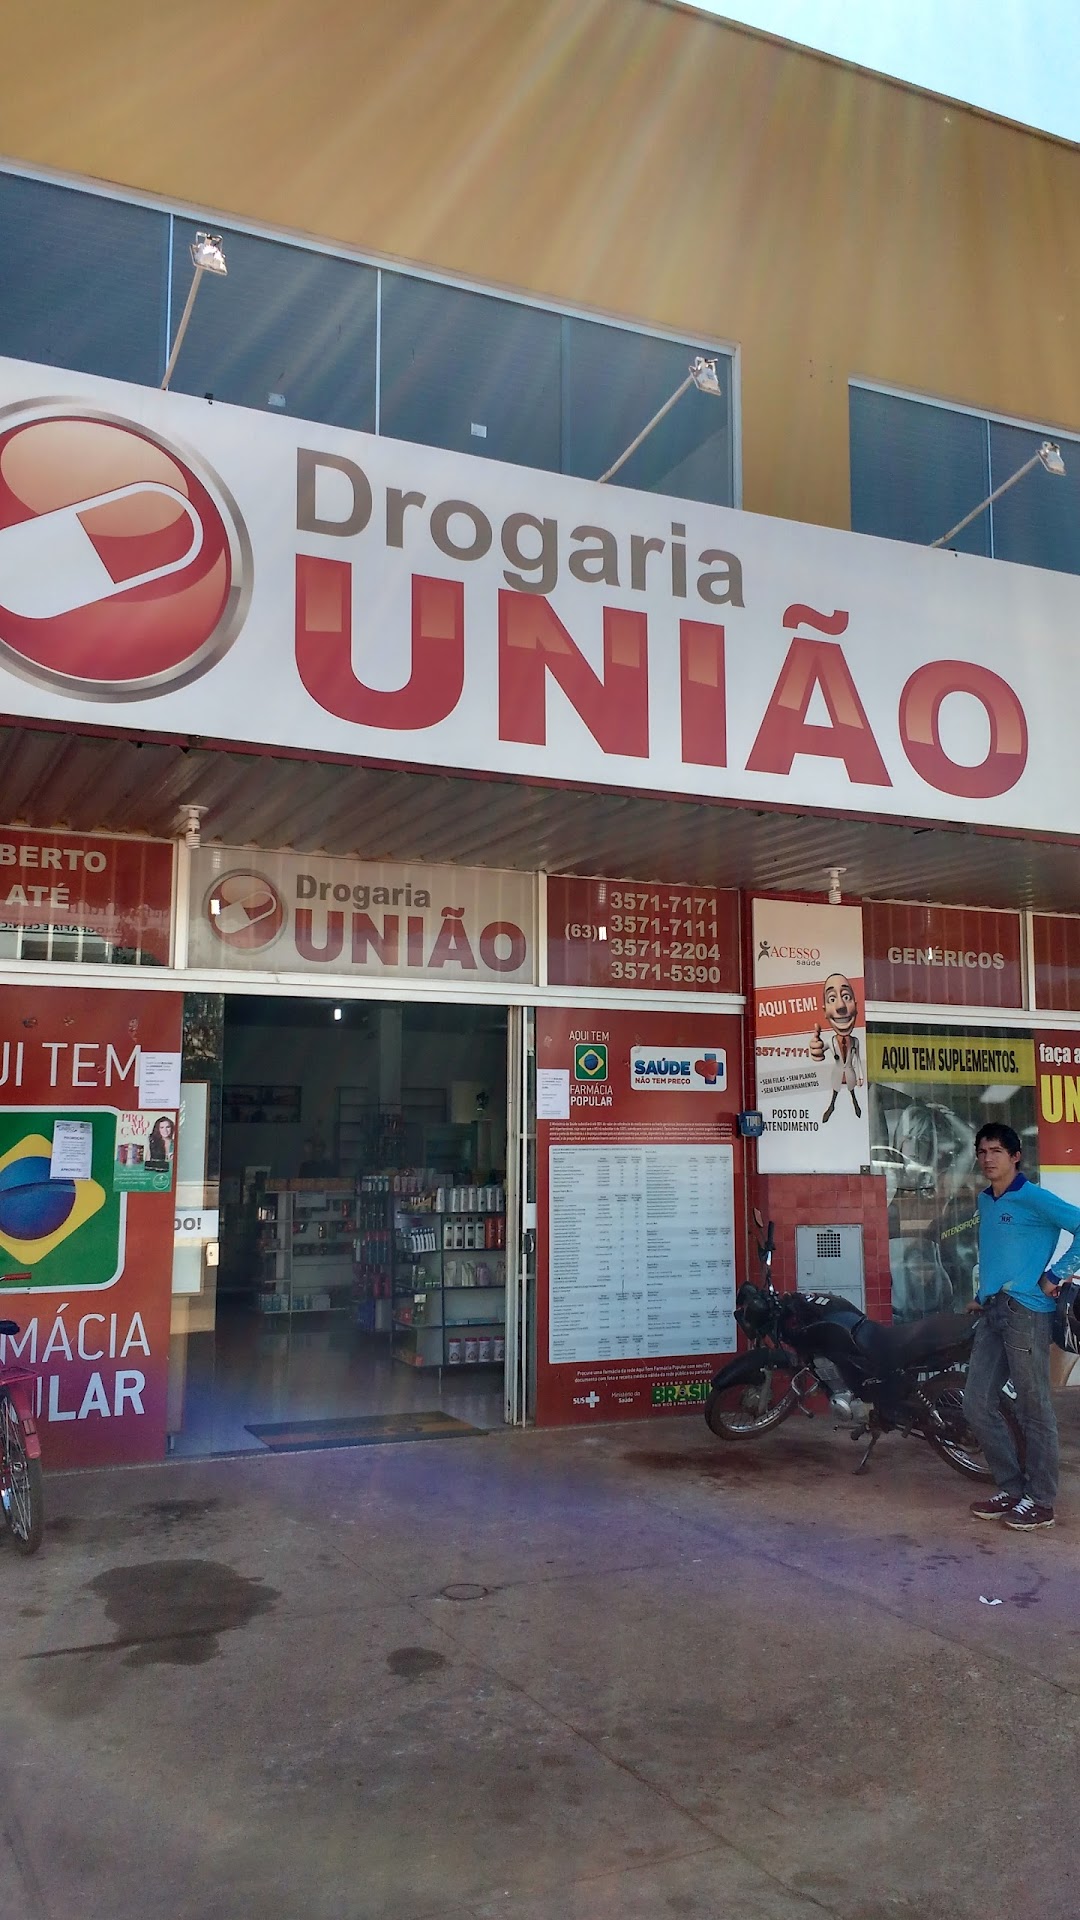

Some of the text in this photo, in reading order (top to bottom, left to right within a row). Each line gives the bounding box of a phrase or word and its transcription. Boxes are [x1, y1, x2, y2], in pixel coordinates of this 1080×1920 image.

[296, 447, 745, 608] Drogaria
[294, 553, 1029, 798] UNIÃO
[5, 883, 71, 909] ATÉ
[295, 874, 431, 909] Drogaria
[611, 891, 718, 916] 3571-7171
[564, 923, 598, 942] (63)
[611, 915, 718, 938] 3571-7111
[294, 906, 526, 972] UNIÃO
[611, 939, 720, 961] 3571-2204
[770, 946, 820, 960] ACESSO
[796, 959, 821, 967] saúde
[887, 945, 1005, 970] GENÉRICOS
[611, 962, 720, 984] 3571-5390
[758, 996, 818, 1018] AQUI TEM!
[569, 1030, 609, 1042] AQUI TEM
[756, 1047, 810, 1057] 3571-7171
[881, 1046, 1019, 1075] AQUI TEM SUPLEMENTOS.
[1039, 1043, 1071, 1066] faça
[42, 1042, 141, 1087] TEM
[634, 1057, 691, 1075] SAÚDE
[570, 1082, 613, 1096] FARMÁCIA
[635, 1076, 650, 1084] NÃO
[762, 1077, 773, 1086] SEM
[789, 1073, 799, 1082] SEM
[799, 1072, 817, 1081] PLANOS
[763, 1081, 820, 1094] SEM ENCAMINHAMENTOS
[570, 1096, 613, 1107] POPULAR
[772, 1109, 809, 1119] POSTO DE
[763, 1121, 819, 1132] ATENDIMENTO
[941, 1215, 980, 1240] INTENSIFIQUE
